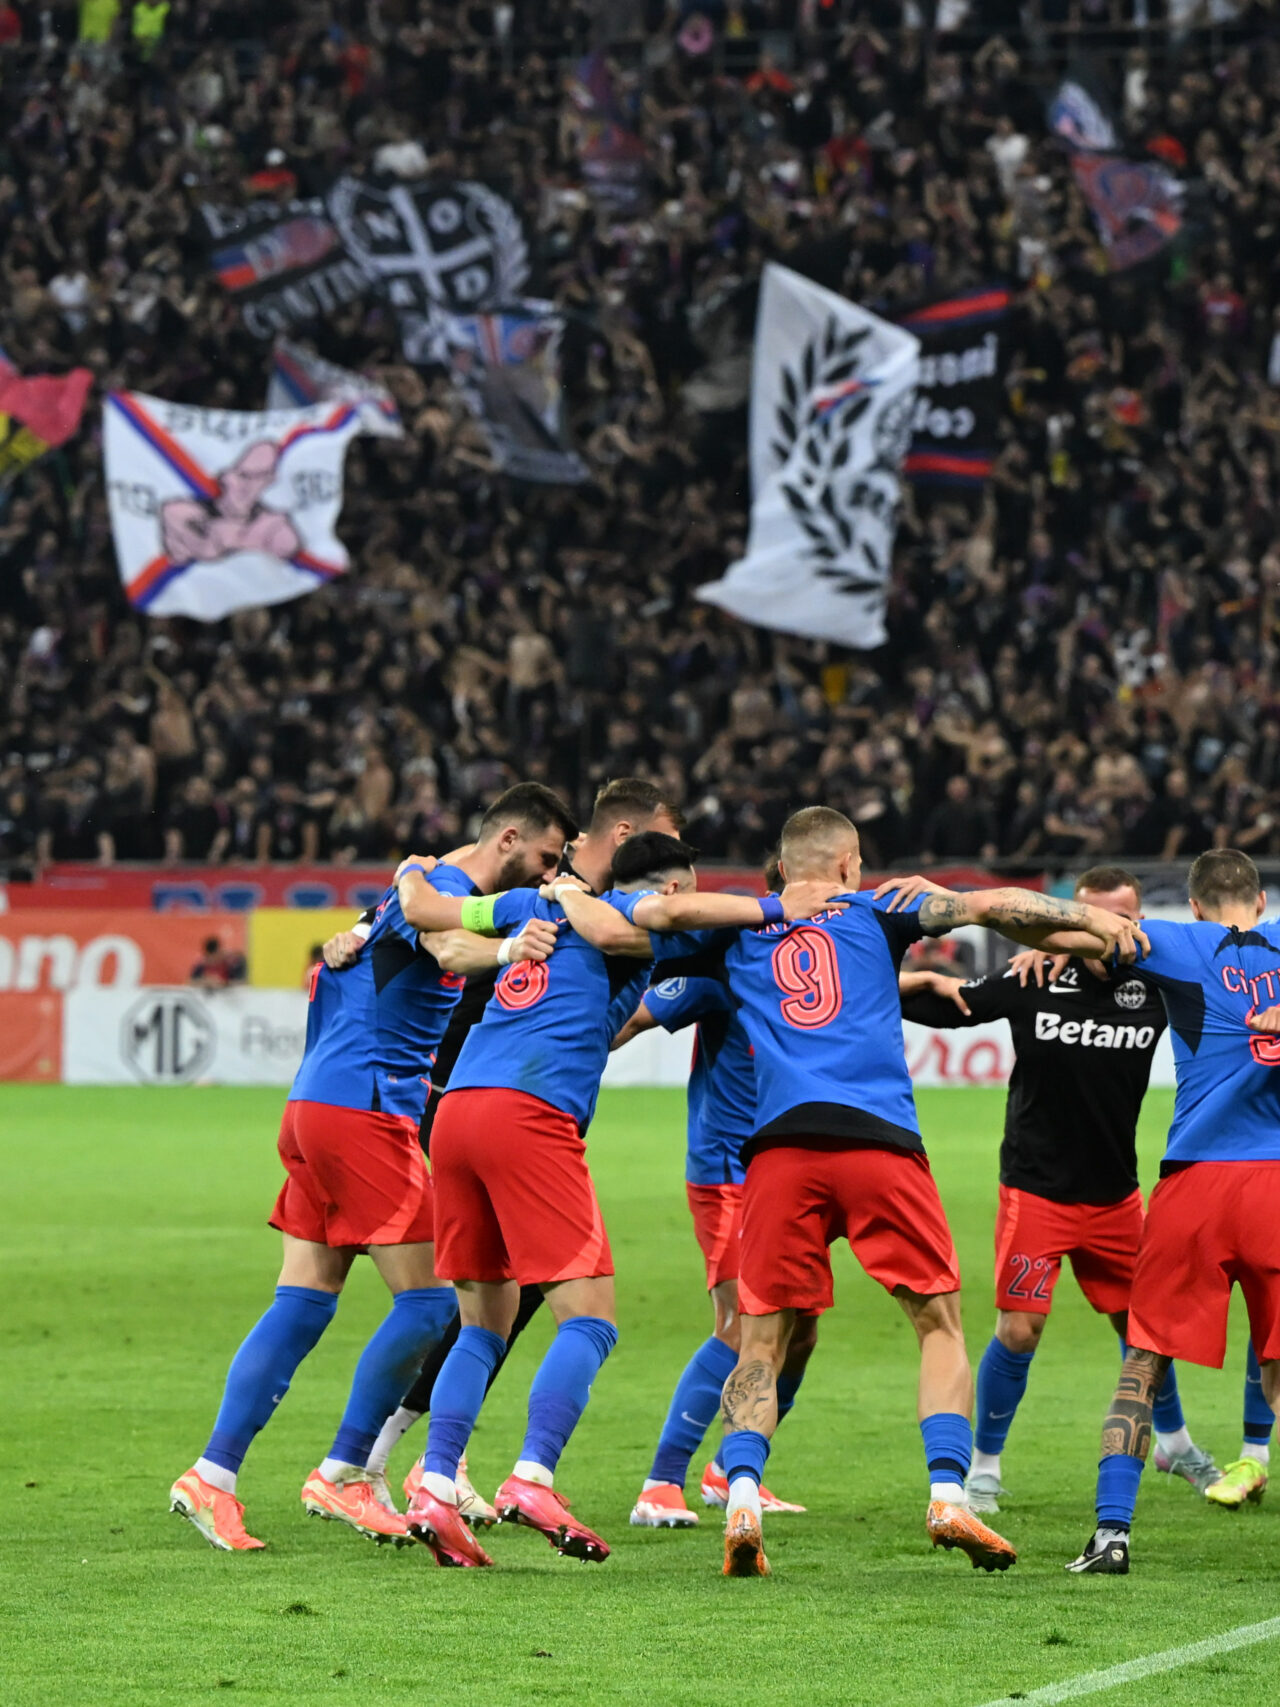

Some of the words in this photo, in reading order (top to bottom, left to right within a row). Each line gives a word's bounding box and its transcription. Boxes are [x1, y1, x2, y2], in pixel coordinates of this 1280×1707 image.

[771, 925, 843, 1030] 9
[1035, 1011, 1156, 1050] Betano
[1006, 1253, 1052, 1301] 22
